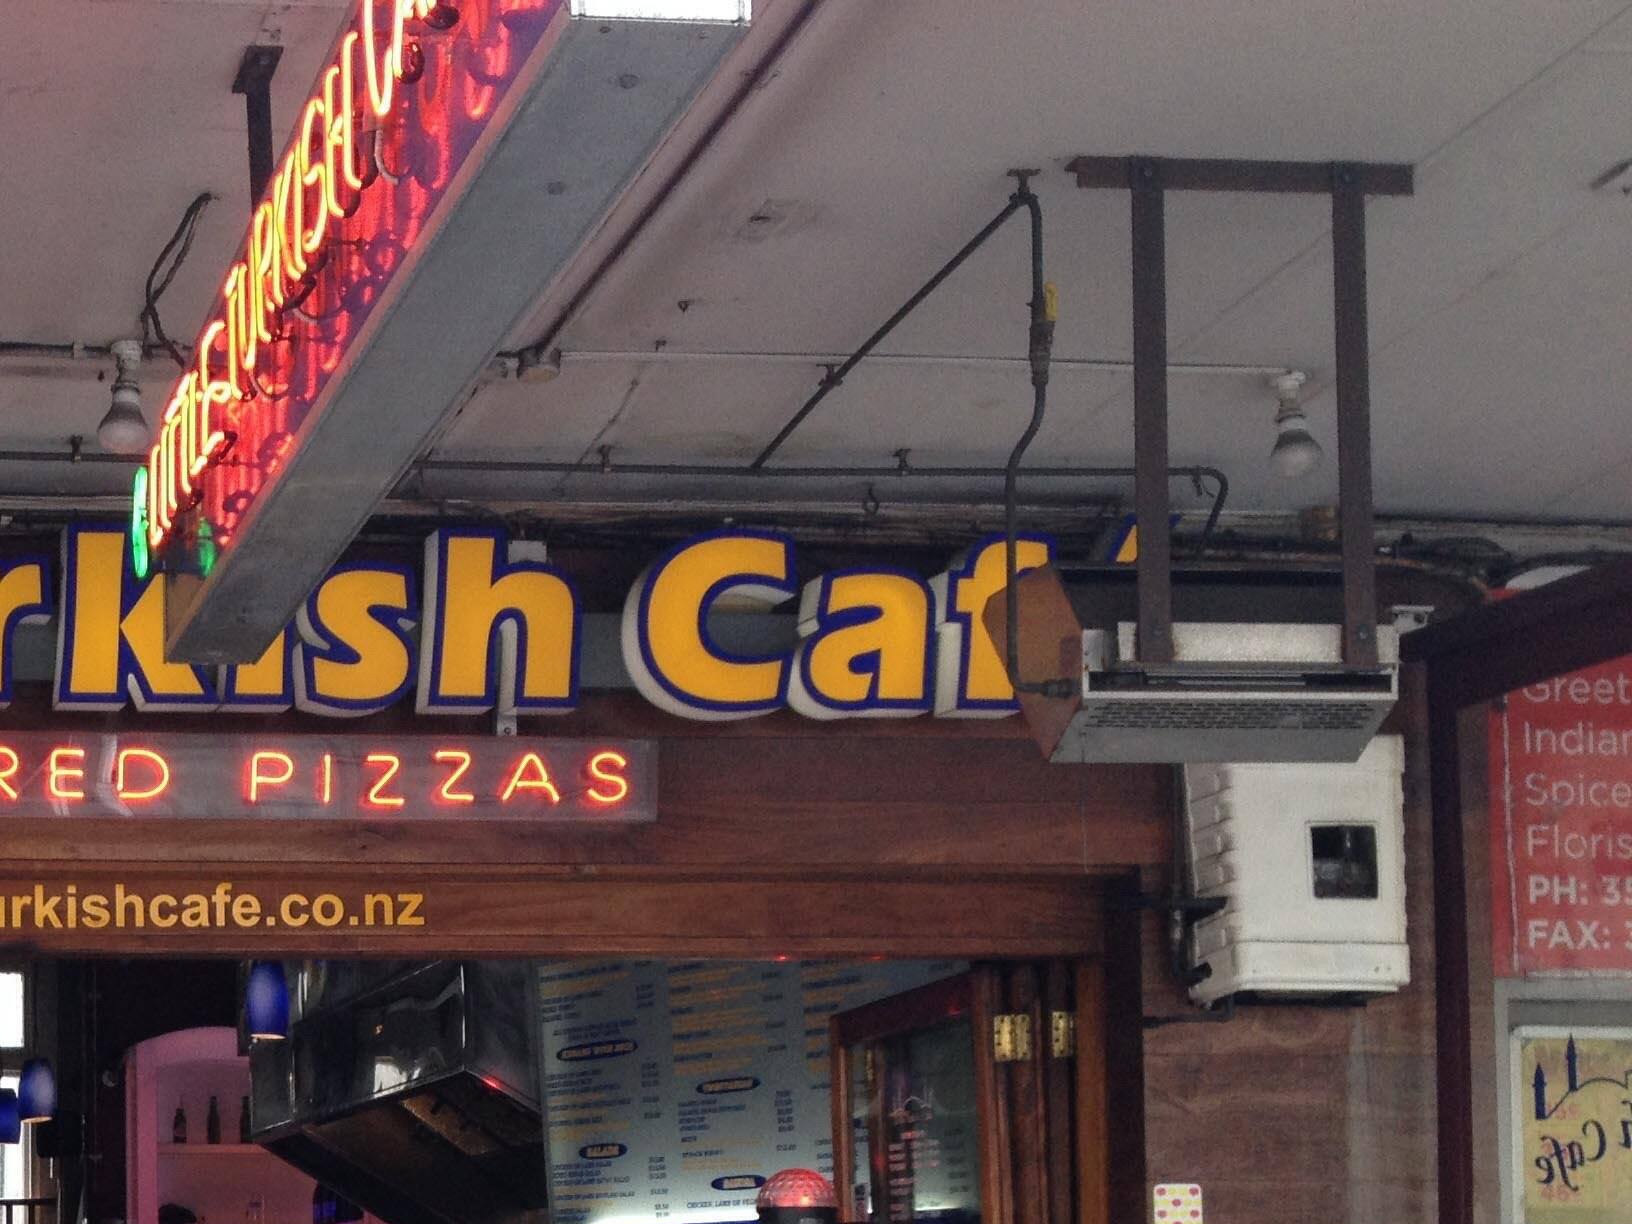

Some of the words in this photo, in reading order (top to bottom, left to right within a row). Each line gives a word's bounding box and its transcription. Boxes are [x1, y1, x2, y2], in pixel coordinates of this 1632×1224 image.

[623, 512, 1183, 722] Caf
[244, 748, 630, 810] PIZZAS
[1527, 874, 1589, 906] PH:
[1527, 920, 1612, 951] FAX:
